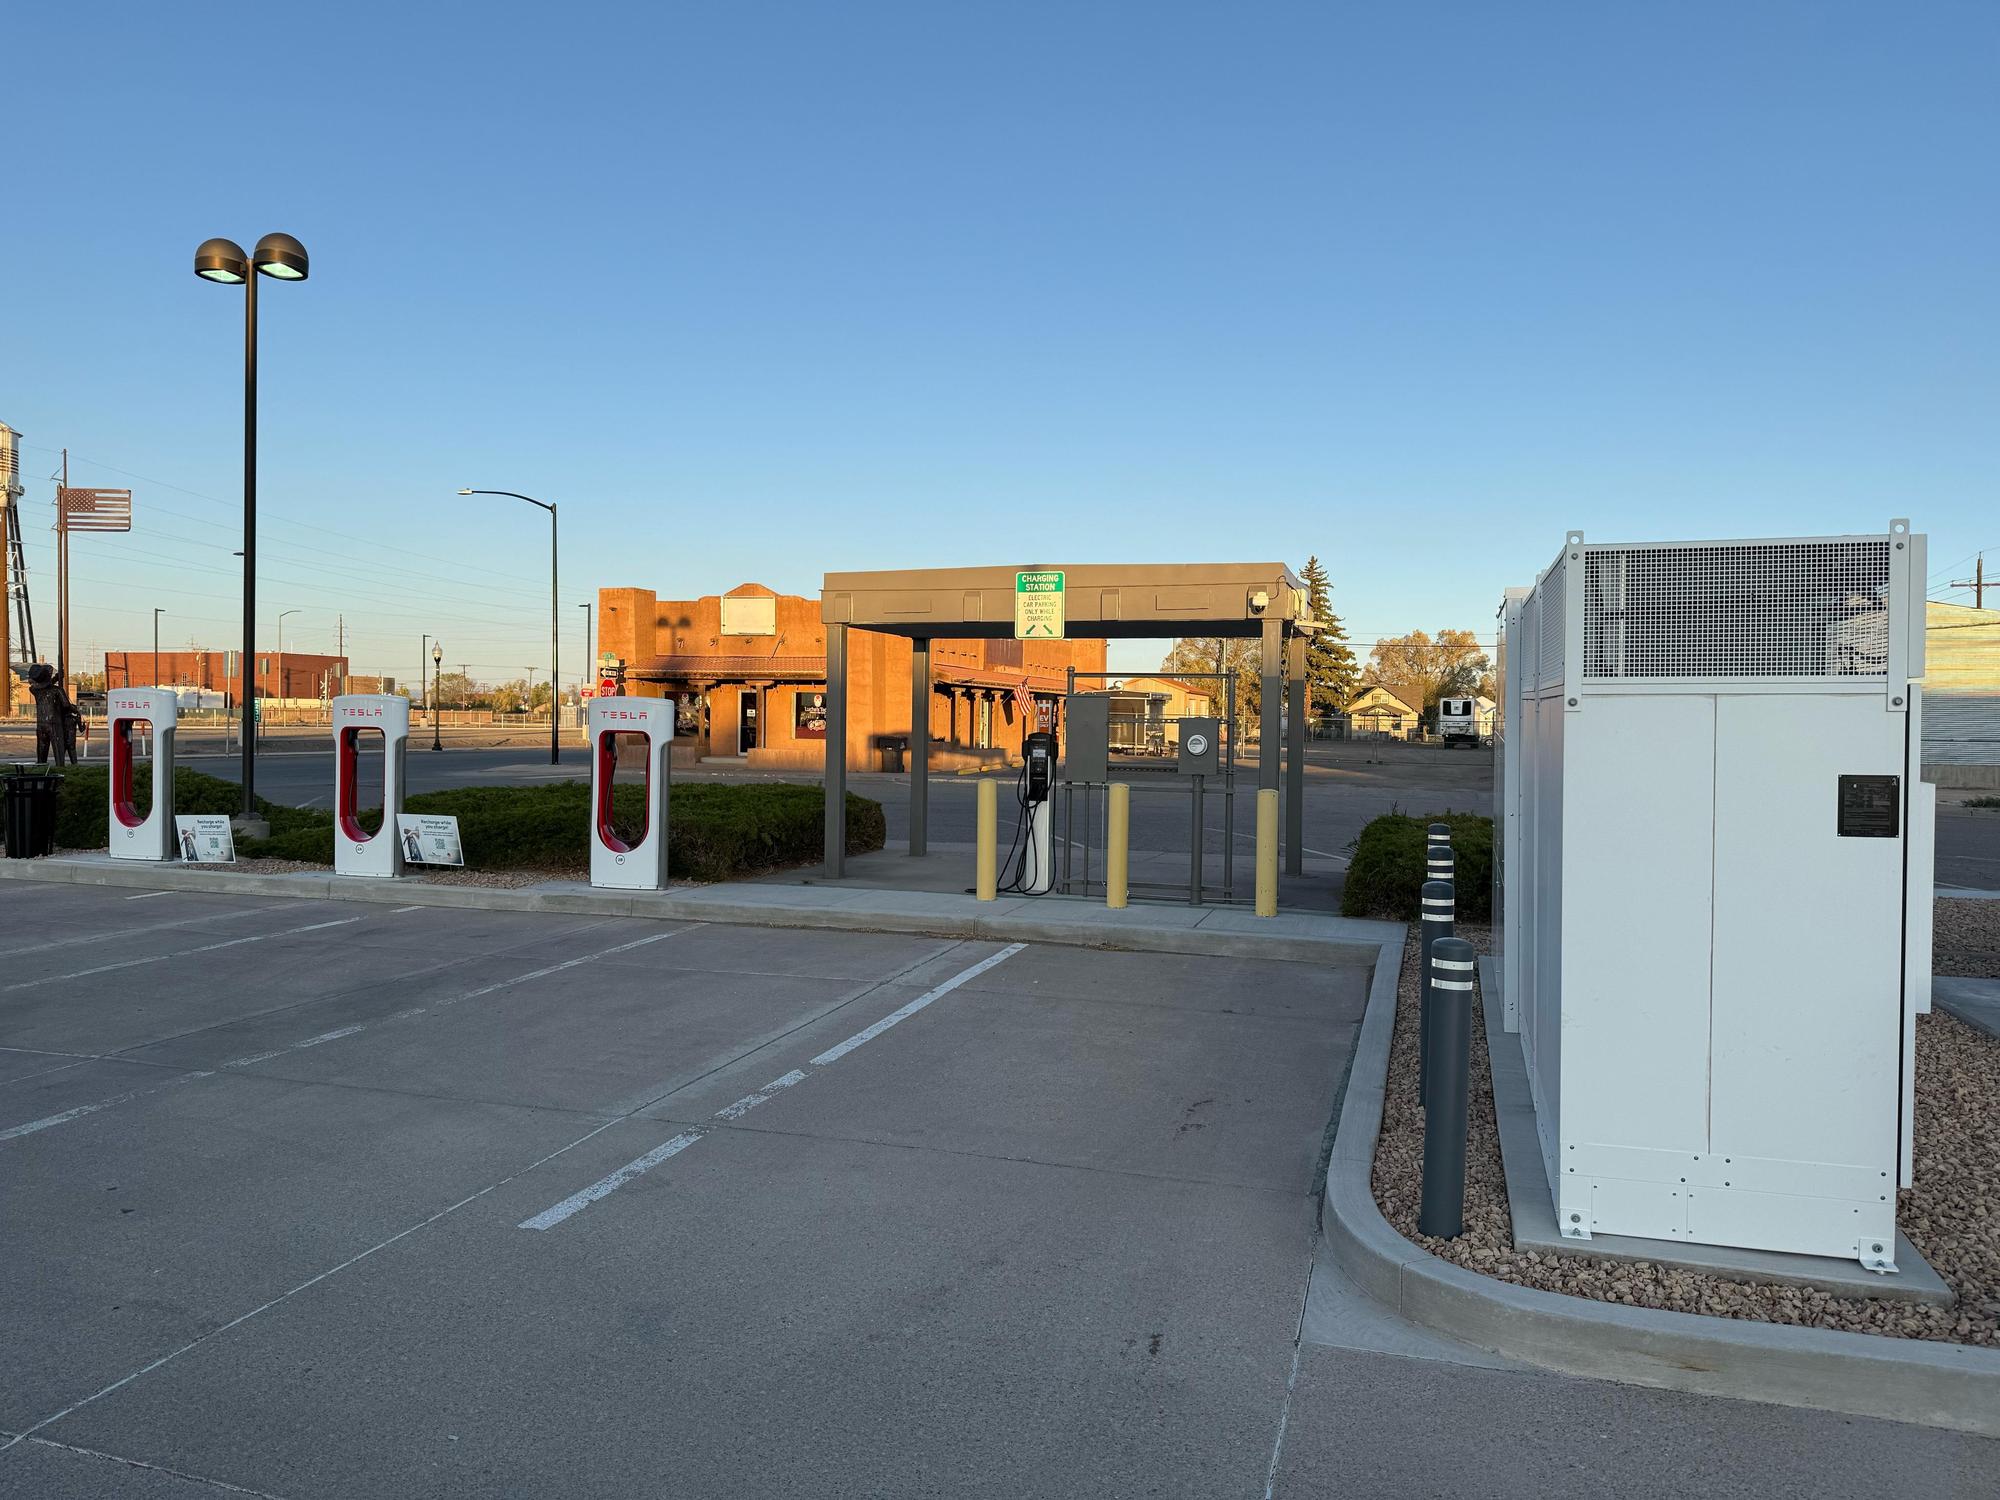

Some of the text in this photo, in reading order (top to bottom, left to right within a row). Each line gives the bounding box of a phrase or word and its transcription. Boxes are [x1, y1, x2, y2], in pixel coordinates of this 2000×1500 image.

[1021, 574, 1059, 583] CHARGING
[1025, 583, 1056, 591] STATION
[601, 686, 616, 696] STOP
[115, 701, 151, 709] TESLA
[341, 708, 383, 717] TESLA
[600, 710, 648, 720] TESLA
[1039, 714, 1049, 722] EV
